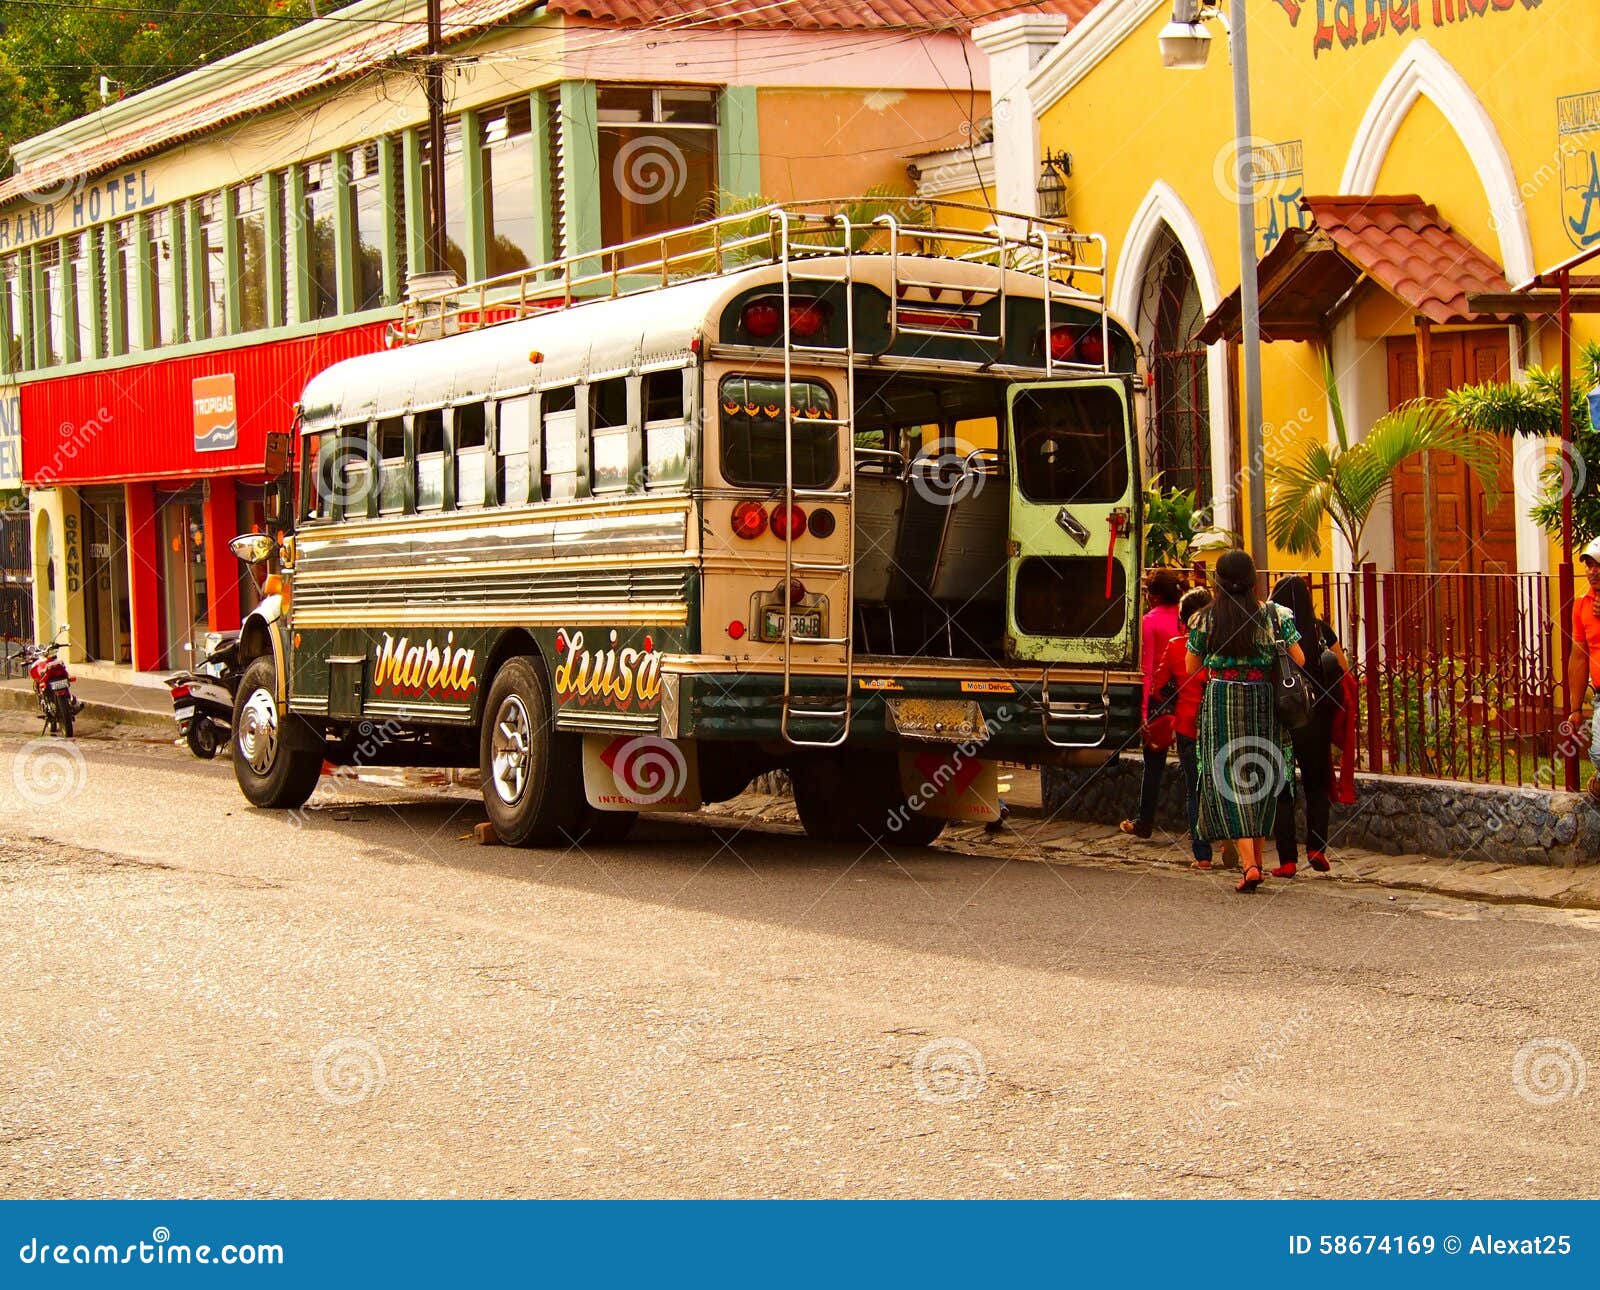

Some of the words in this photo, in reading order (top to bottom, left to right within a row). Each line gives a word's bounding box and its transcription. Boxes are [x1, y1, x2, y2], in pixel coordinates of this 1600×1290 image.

[72, 169, 155, 228] HOTEL
[194, 396, 234, 415] TROPIGAS
[64, 514, 78, 593] GRAND
[374, 630, 477, 695] Maria
[555, 628, 663, 703] Luisa
